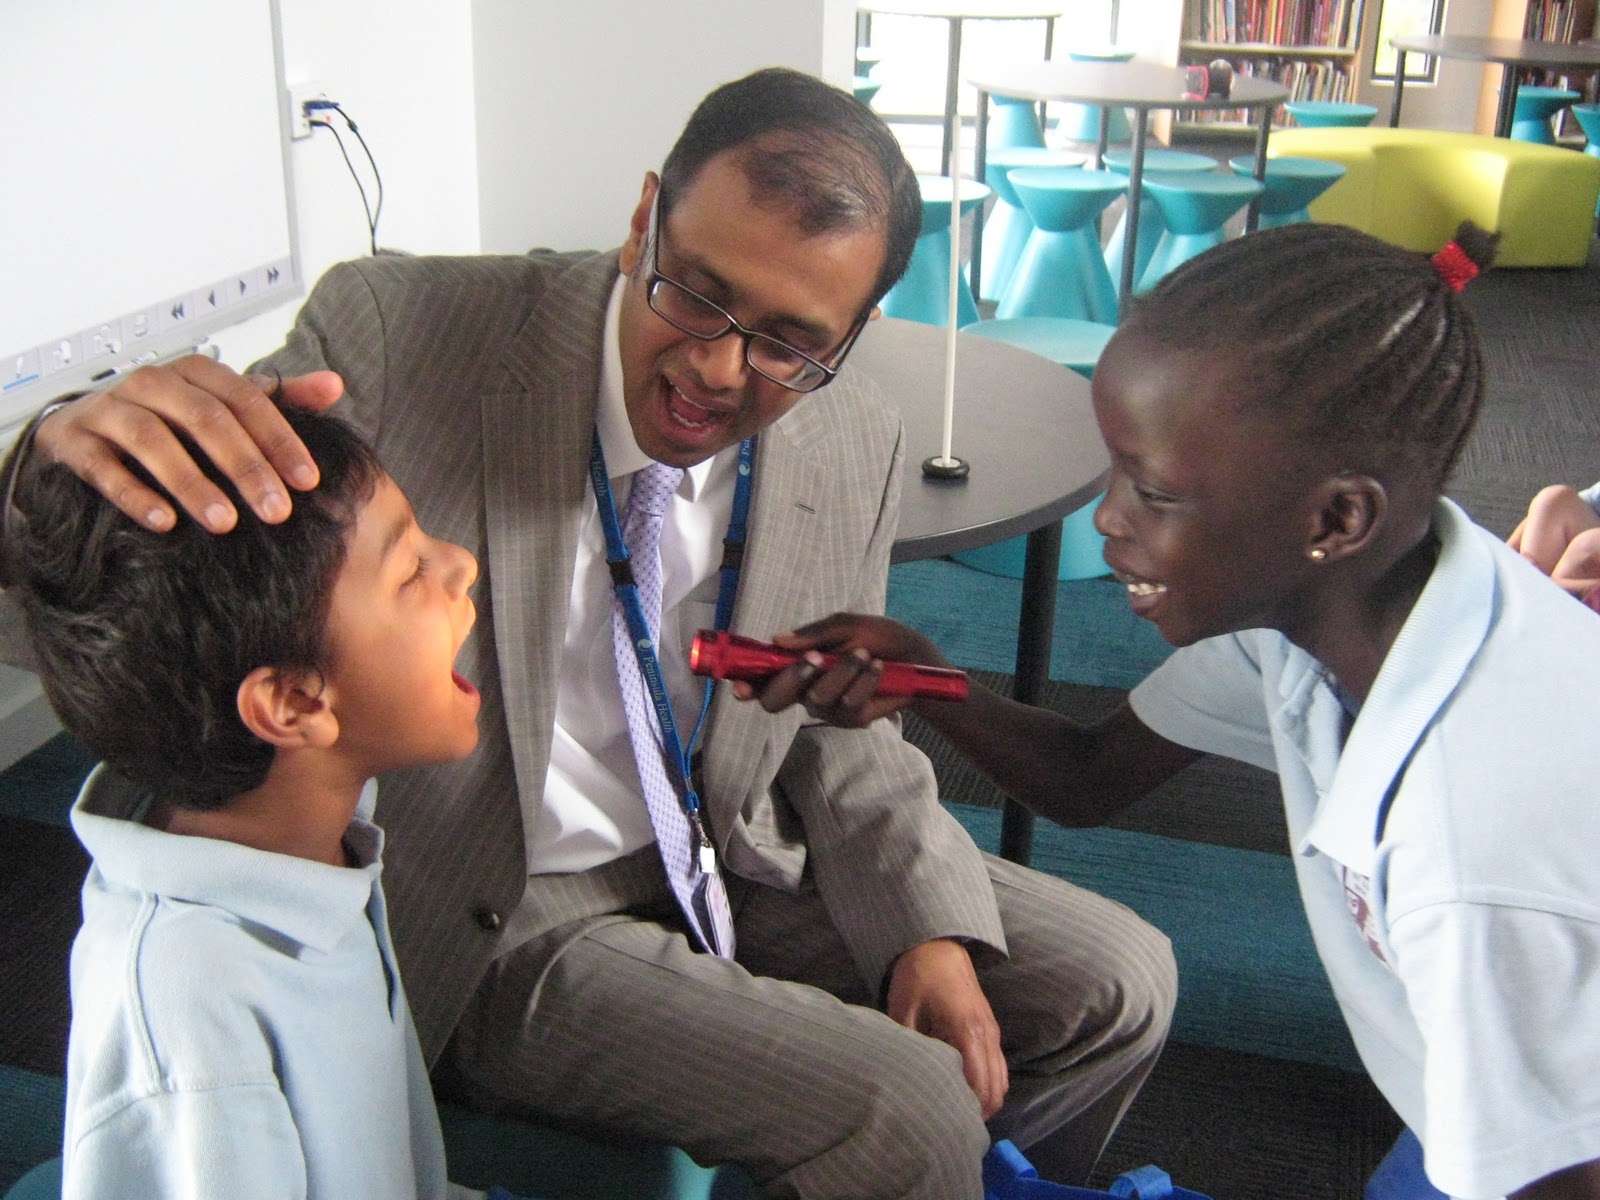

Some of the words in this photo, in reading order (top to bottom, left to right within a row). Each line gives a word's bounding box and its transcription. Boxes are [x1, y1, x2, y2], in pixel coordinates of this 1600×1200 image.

[592, 461, 607, 496] Health
[643, 656, 663, 701] Peninsula
[657, 703, 673, 733] Health
